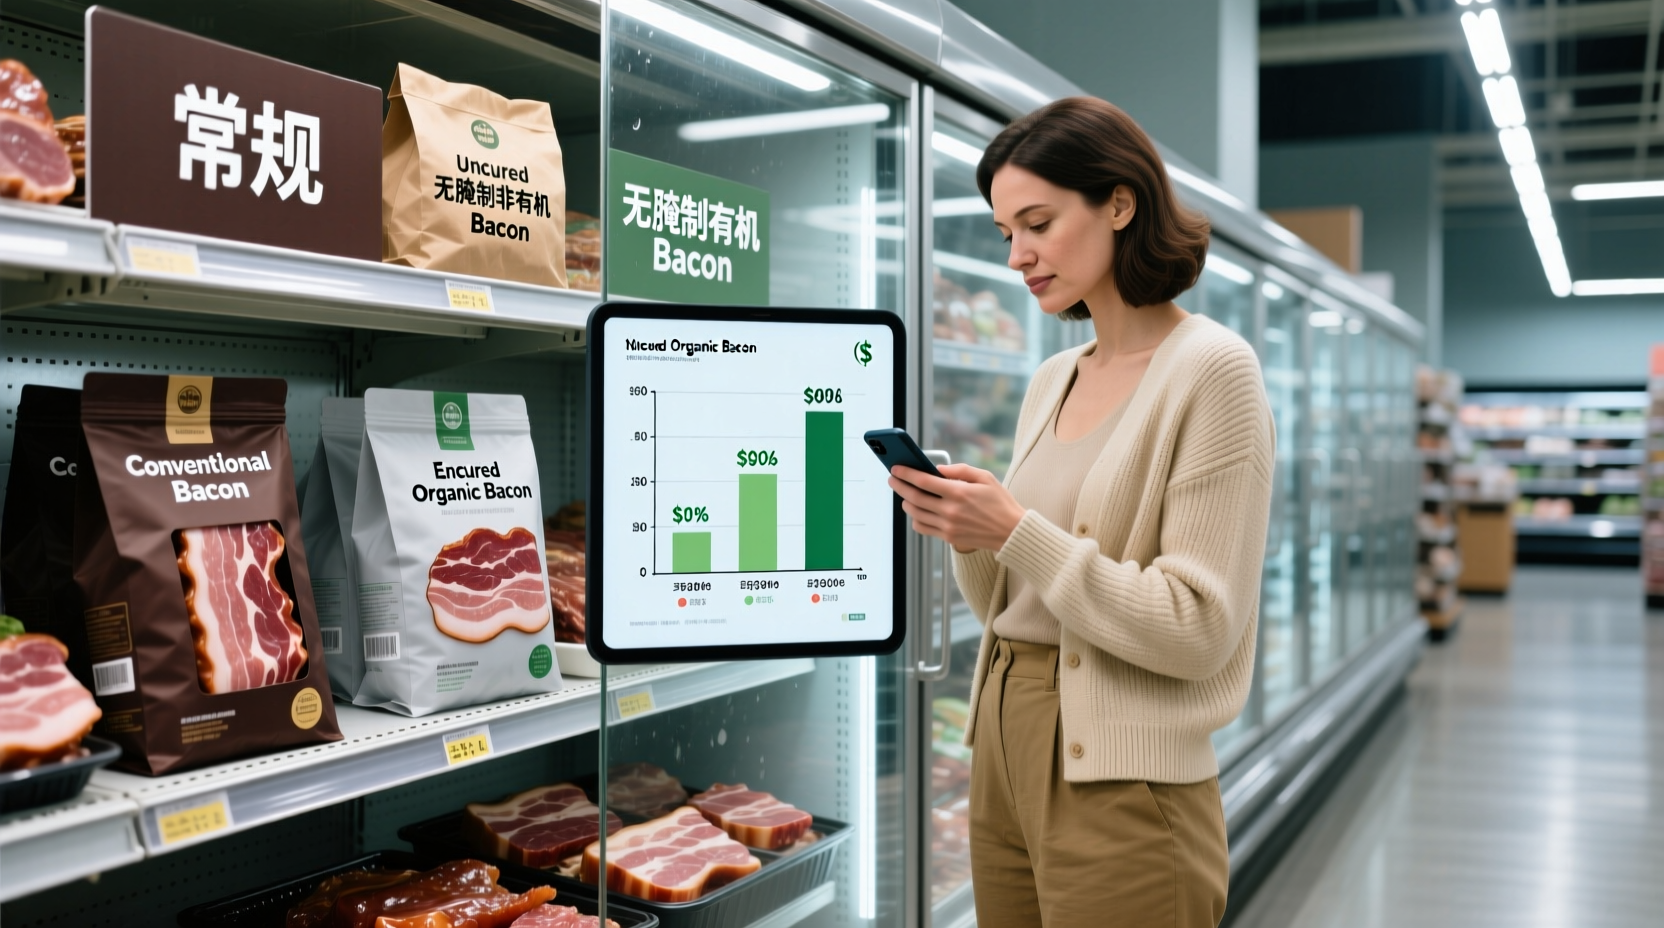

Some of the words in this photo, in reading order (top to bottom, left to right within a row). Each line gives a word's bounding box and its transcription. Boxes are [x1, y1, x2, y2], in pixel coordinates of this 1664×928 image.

[174, 83, 324, 205] 常规
[456, 154, 529, 183] Uncured
[434, 174, 551, 218] 无腌制非有机
[471, 212, 529, 242] Bacon
[622, 182, 761, 252] 无腌制有机
[653, 237, 732, 283] Bacon
[670, 338, 718, 356] Organic
[125, 450, 272, 477] Conventional
[433, 461, 501, 479] Encured
[171, 480, 250, 503] Bacon
[412, 482, 481, 506] Organic
[483, 482, 532, 499] Bacon
